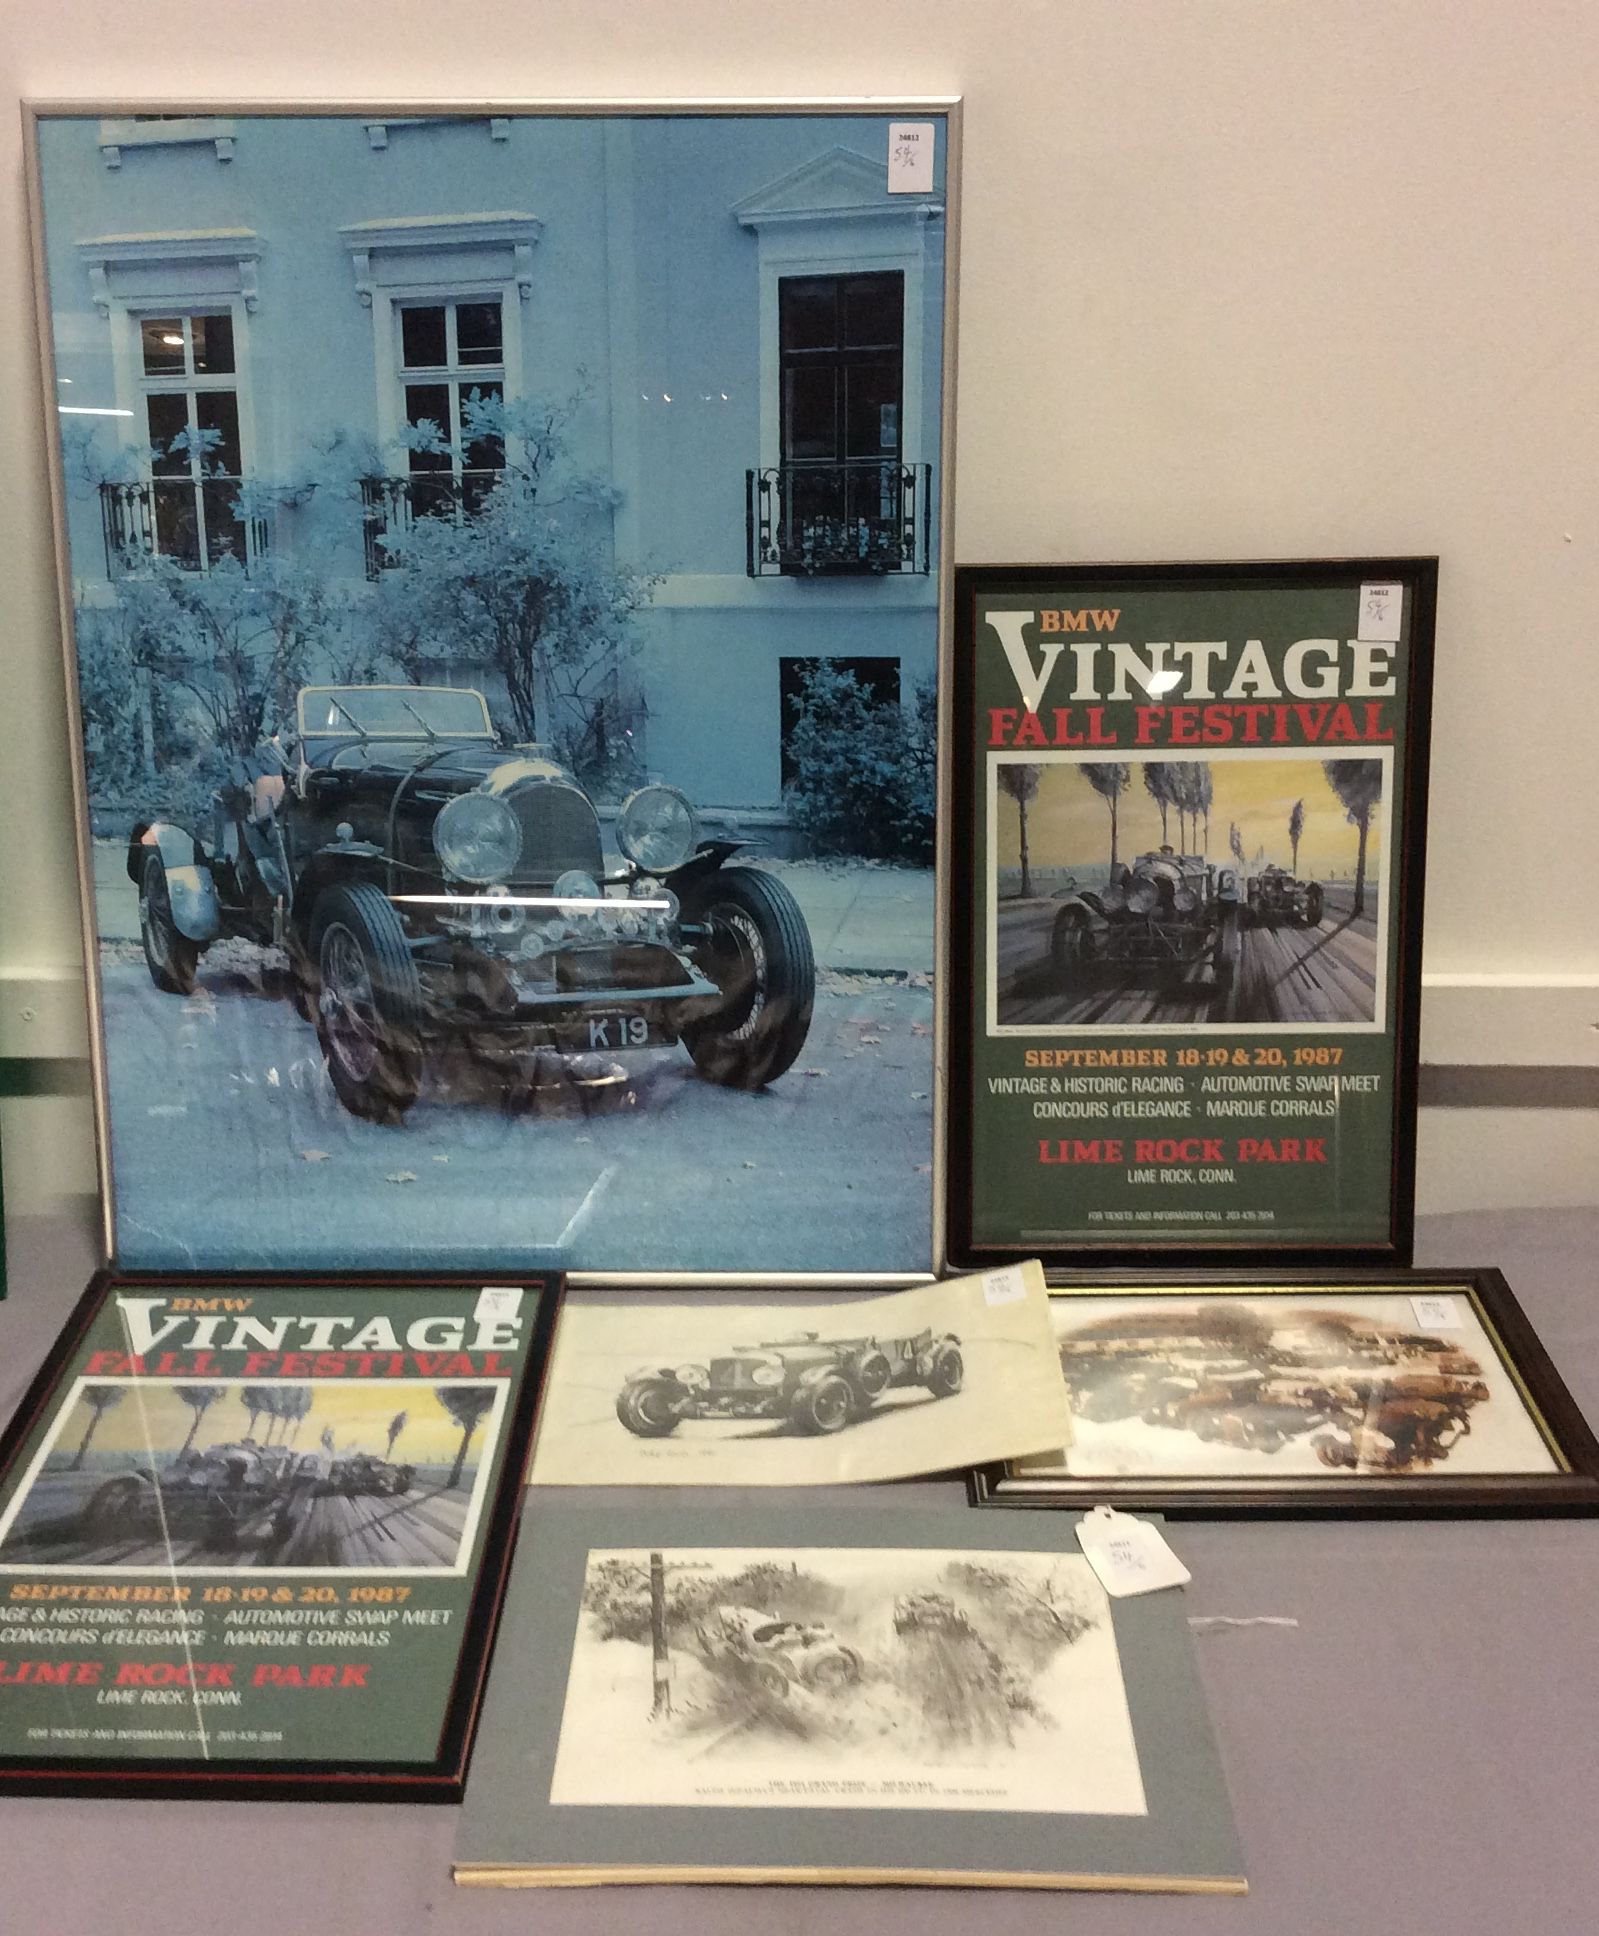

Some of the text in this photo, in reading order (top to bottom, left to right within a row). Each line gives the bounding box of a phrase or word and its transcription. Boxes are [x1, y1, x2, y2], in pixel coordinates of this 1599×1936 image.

[1040, 609, 1121, 632] BMW
[985, 611, 1396, 714] VINTAGE
[988, 703, 1394, 745] FALL FESTIVAL
[589, 1016, 649, 1047] K 19
[1024, 1050, 1168, 1068] SEPTEMBER
[1231, 1047, 1250, 1067] &
[1253, 1048, 1288, 1069] 20,
[1293, 1048, 1343, 1067] 1987
[988, 1076, 1185, 1094] VINTAGE & HISTORIC RACING
[1200, 1075, 1292, 1093] AUTOMOTIVE
[1341, 1075, 1381, 1092] MEET
[1033, 1100, 1192, 1119] CONCOURS d'ELEGANCE
[1206, 1099, 1335, 1117] MARQUE CORRALS
[1038, 1137, 1328, 1164] LIME ROCK PARK
[1127, 1168, 1237, 1185] LIME ROCK, CONN.
[171, 1297, 254, 1312] BMW
[115, 1297, 522, 1356] VINTAGE
[83, 1351, 512, 1377] FALL FESTIVAL
[10, 1584, 191, 1602] SEPTEMBER
[349, 1586, 412, 1604] 1987
[50, 1607, 133, 1624] HISTORIC
[136, 1608, 205, 1625] RACING
[223, 1609, 453, 1625] AUTOMOTIVE SWAP MEET
[0, 1626, 206, 1646] CONCOURS d'ELEGANCE
[223, 1629, 391, 1647] MARQUE CORRALS
[0, 1660, 373, 1688] LIME ROCK PARK
[96, 1689, 138, 1704] LIME
